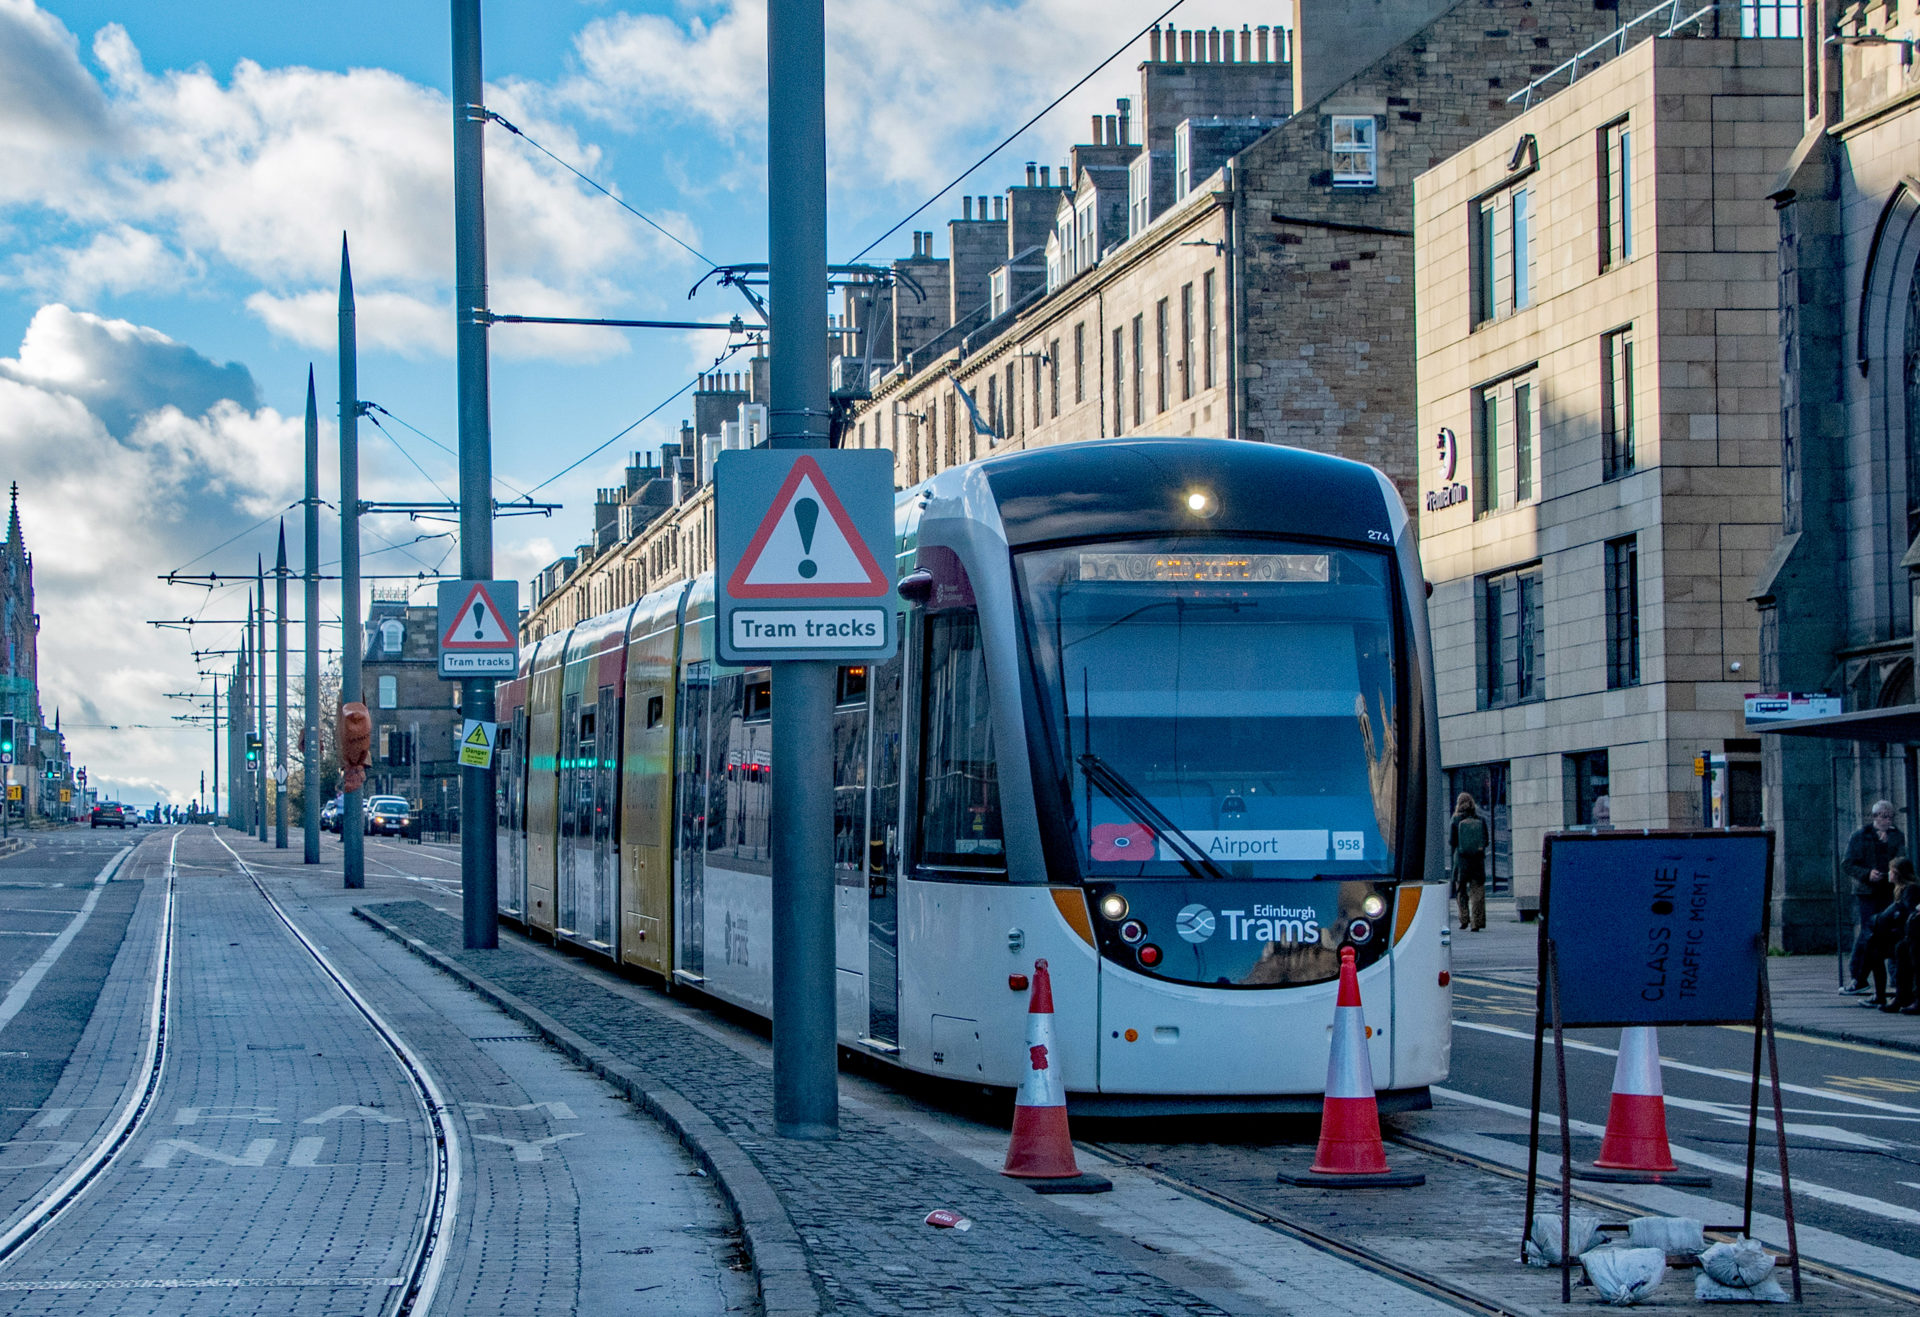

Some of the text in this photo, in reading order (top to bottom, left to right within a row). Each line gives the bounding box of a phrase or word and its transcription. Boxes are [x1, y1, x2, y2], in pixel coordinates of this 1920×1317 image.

[1368, 530, 1390, 542] 274
[741, 619, 876, 637] Tram tracks
[448, 656, 510, 666] Tram tracks
[465, 747, 487, 756] Danger
[1209, 837, 1278, 857] Airport
[1337, 839, 1360, 850] 958
[1254, 905, 1315, 920] Edinburgh
[1221, 910, 1319, 943] Trams
[1641, 868, 1678, 1001] CLASS ONE
[1680, 871, 1711, 1000] TRAFFIC MGMT
